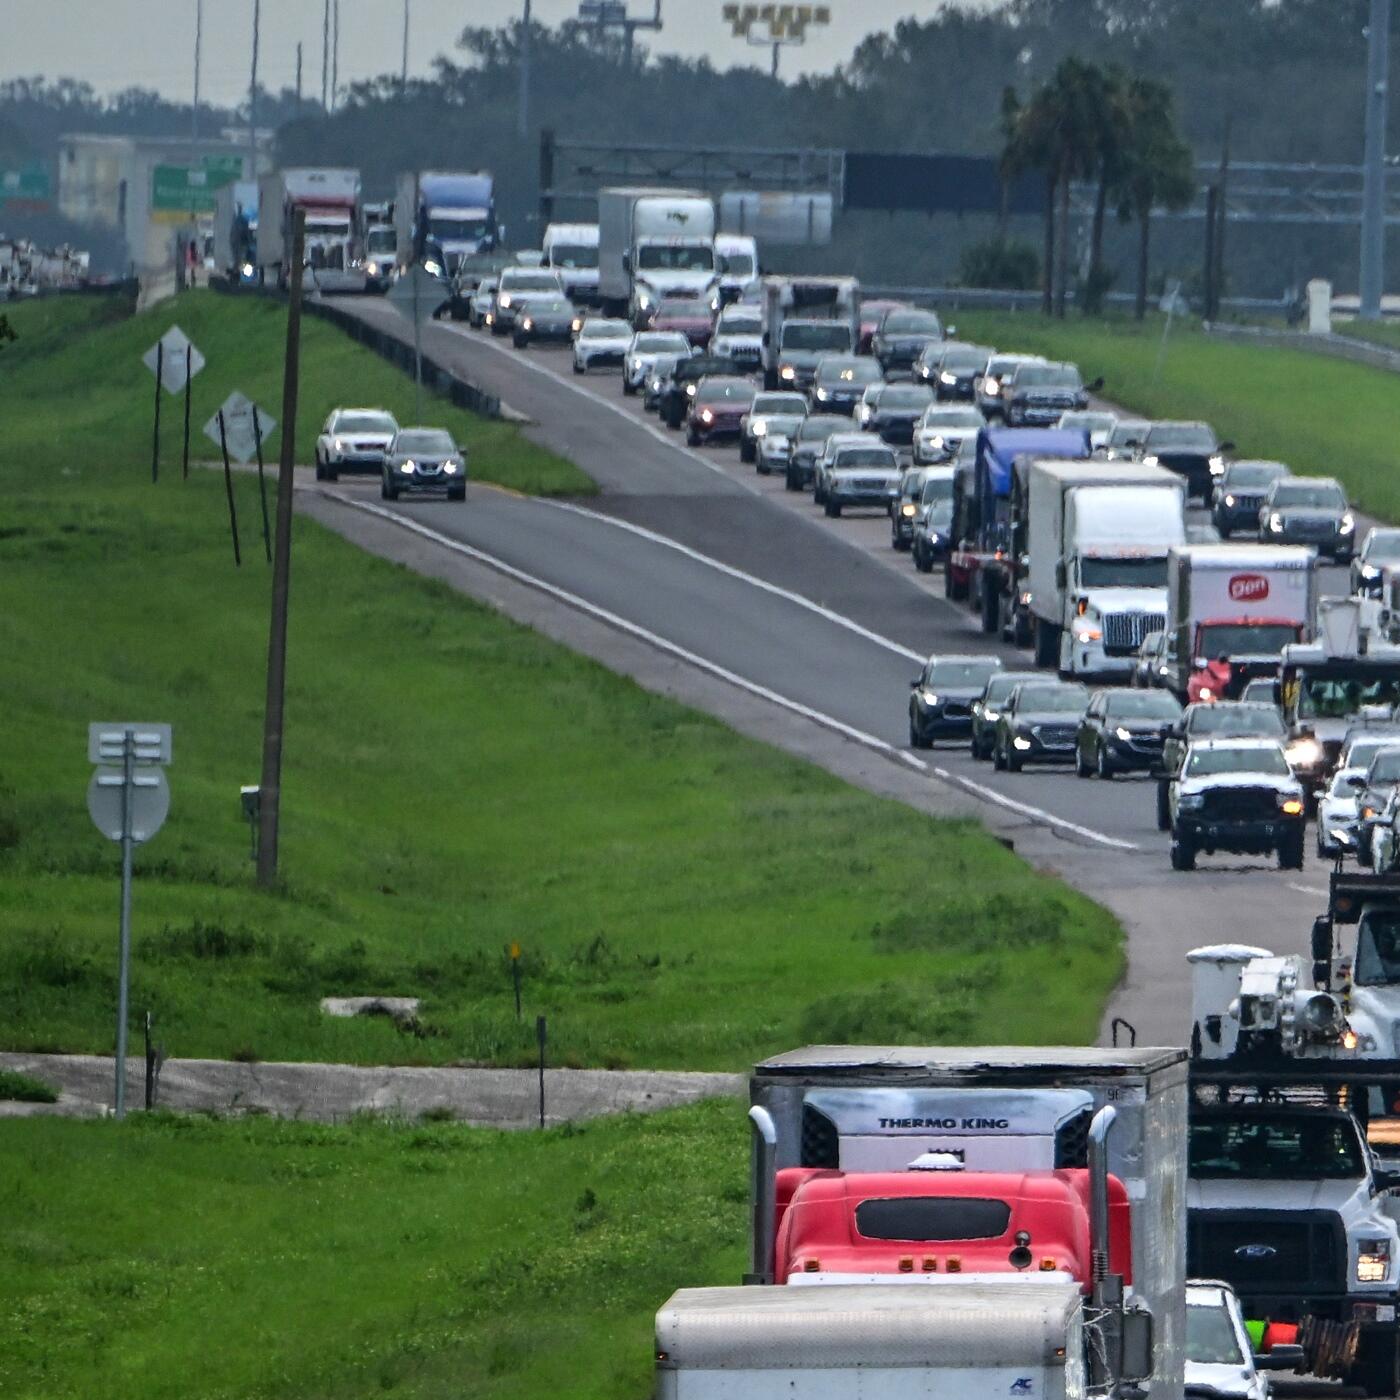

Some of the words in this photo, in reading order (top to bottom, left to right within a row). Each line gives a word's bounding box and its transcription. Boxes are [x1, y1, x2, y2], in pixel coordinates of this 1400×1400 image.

[878, 1118, 957, 1129] THERMO
[960, 1118, 1009, 1129] KING
[1009, 1377, 1033, 1389] AC
